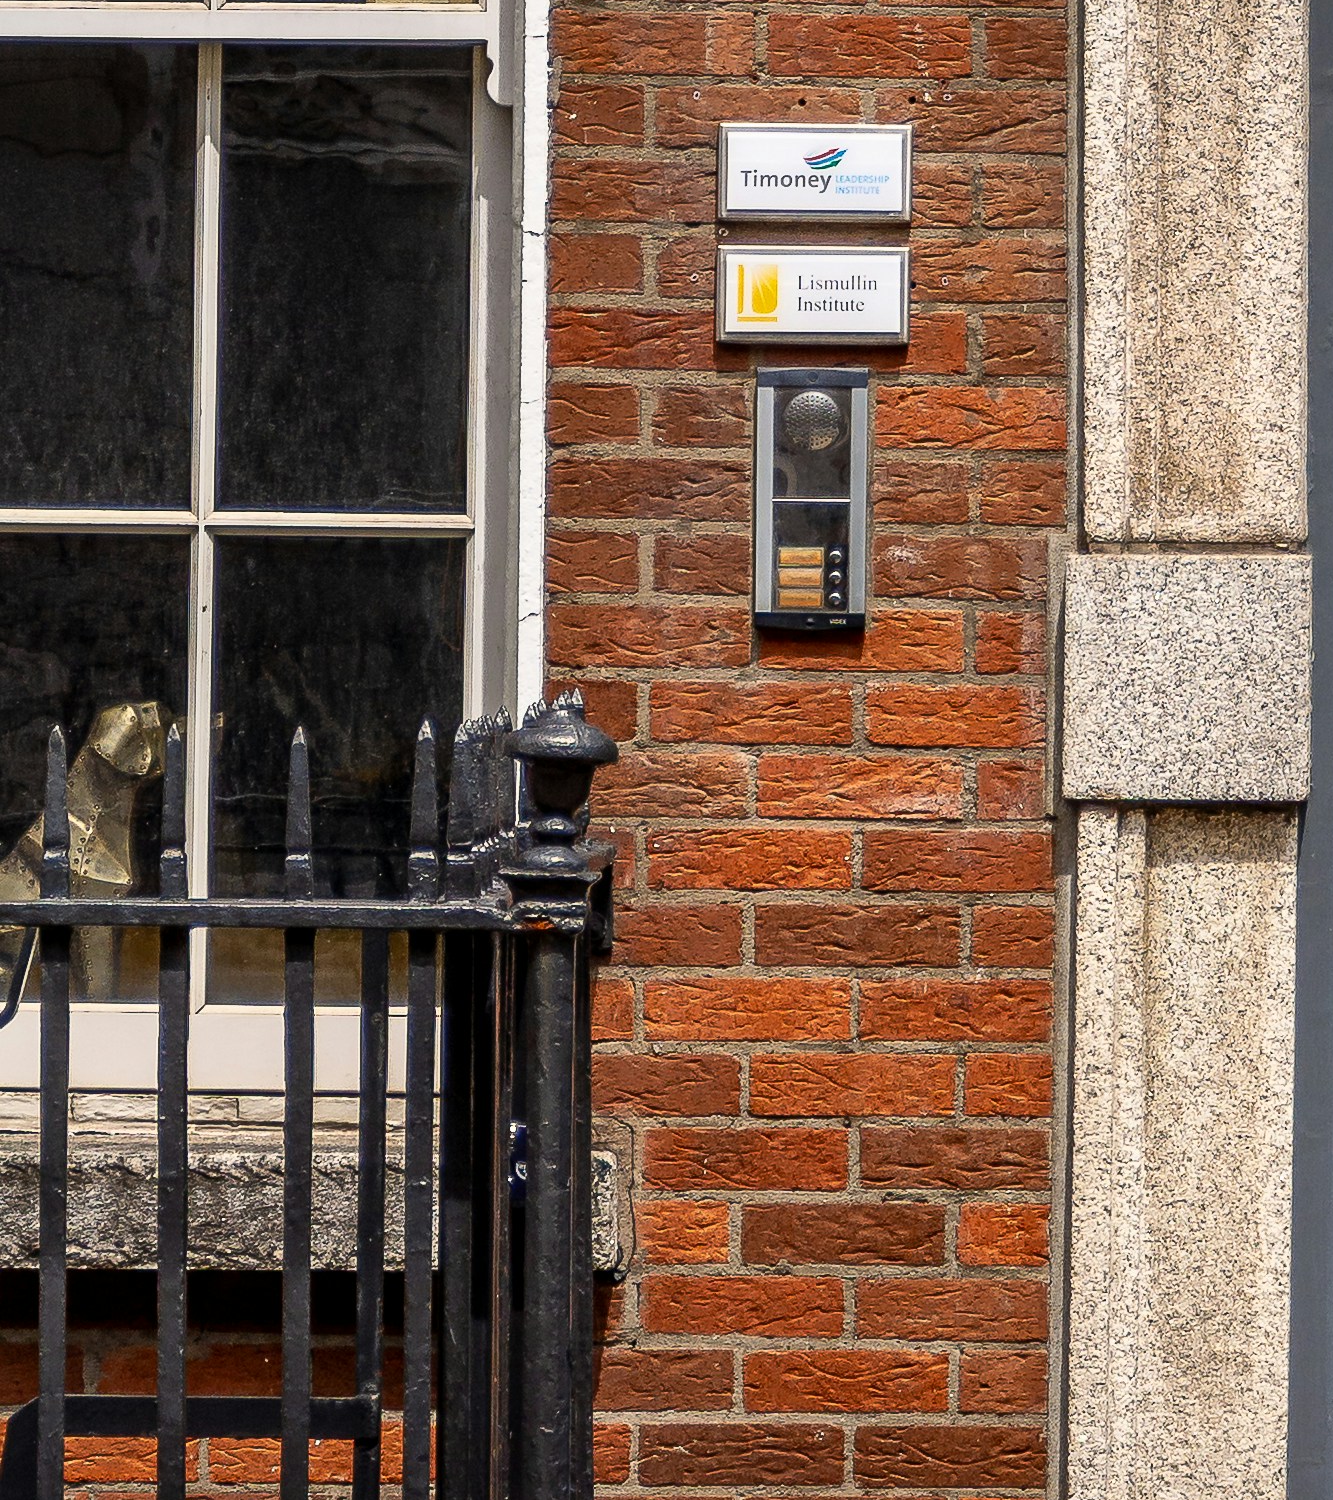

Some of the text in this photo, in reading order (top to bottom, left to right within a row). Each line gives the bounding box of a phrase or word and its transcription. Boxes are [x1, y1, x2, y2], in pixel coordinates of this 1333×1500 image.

[740, 169, 890, 194] Timoney LEADERSHIP
[835, 186, 881, 195] INSTITUTE
[797, 274, 878, 291] Lismullin
[797, 296, 866, 312] Institute
